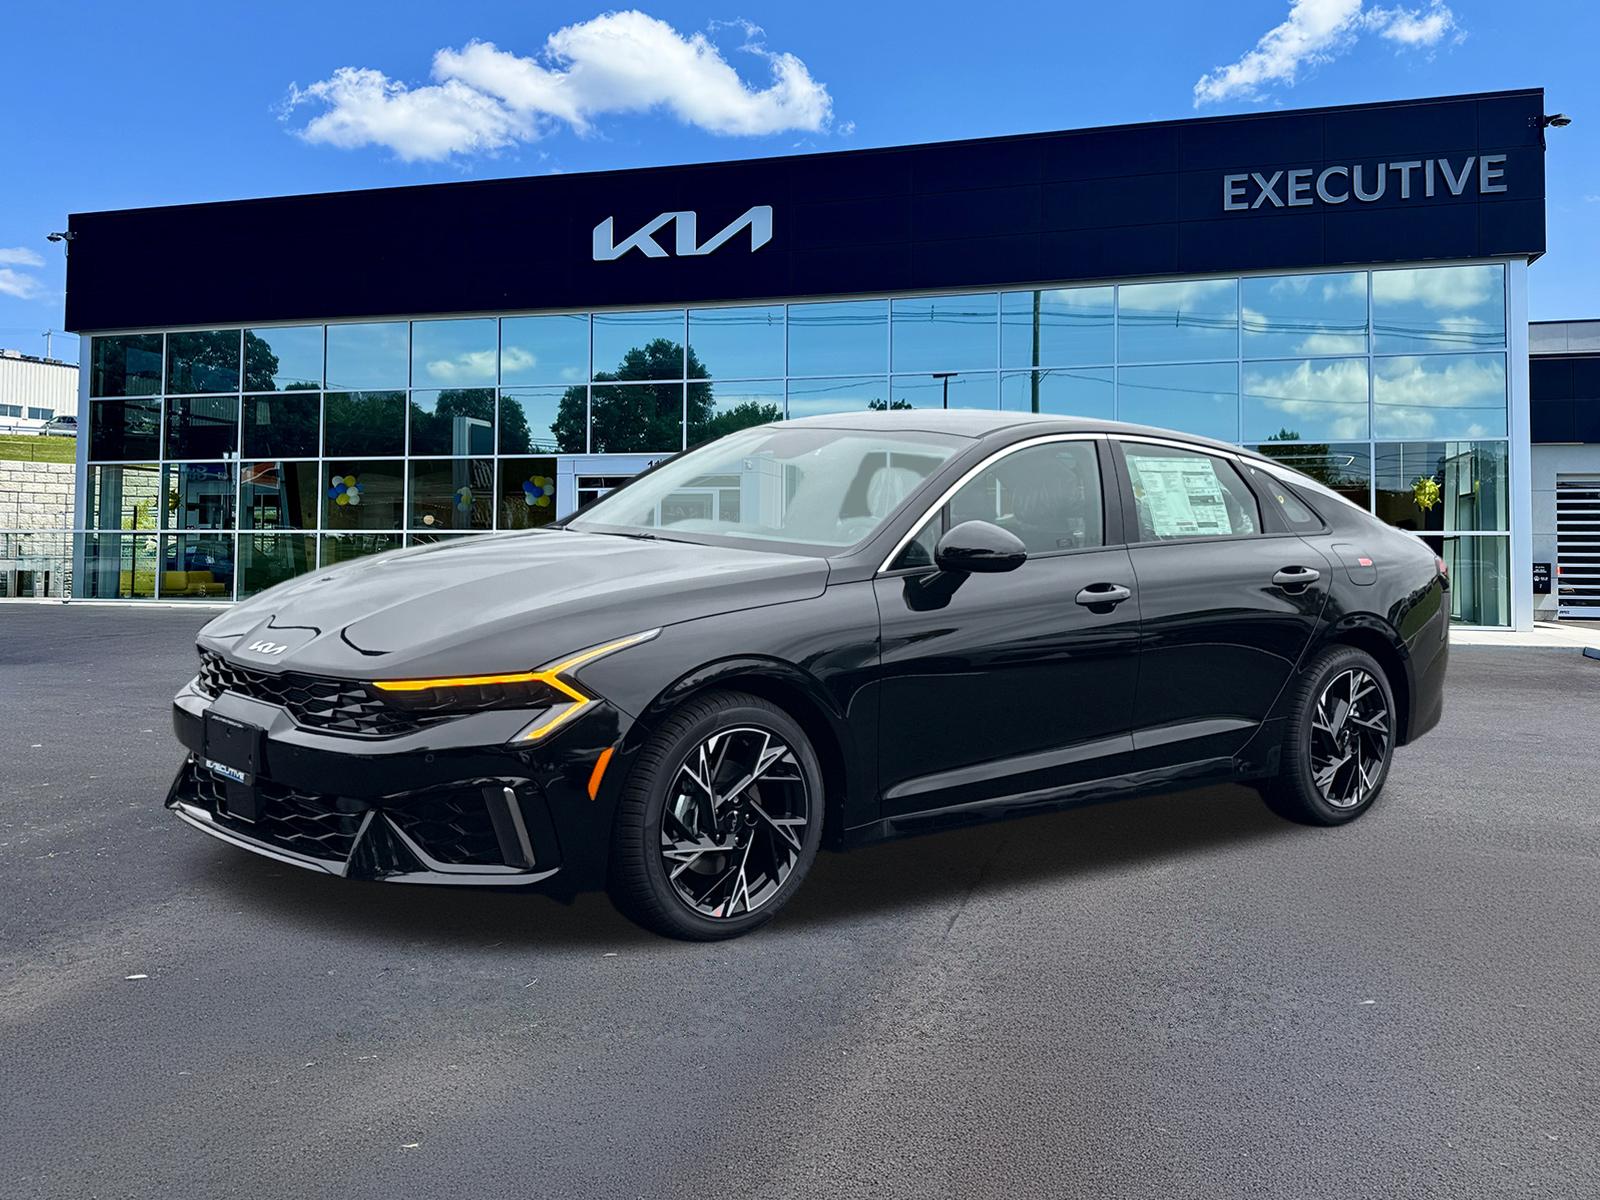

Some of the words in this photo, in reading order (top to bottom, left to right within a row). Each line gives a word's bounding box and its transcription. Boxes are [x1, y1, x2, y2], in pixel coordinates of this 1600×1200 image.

[1223, 155, 1508, 211] EXECUTIVE
[593, 205, 773, 261] KIA
[248, 640, 288, 655] KIA
